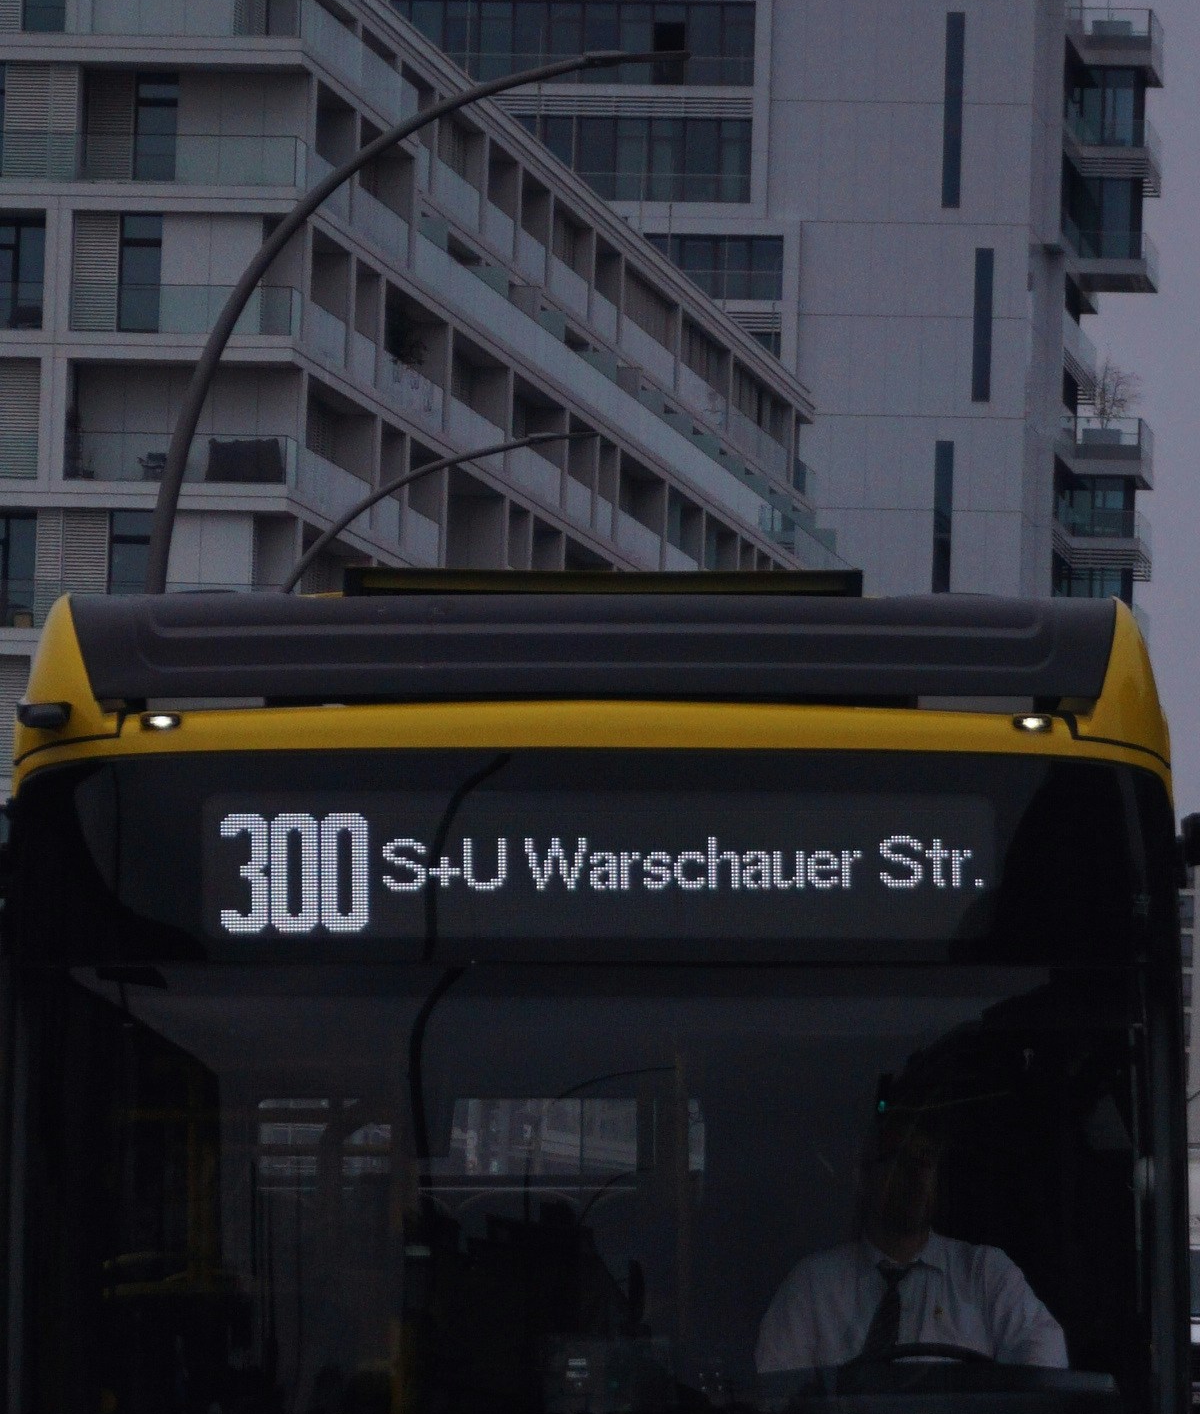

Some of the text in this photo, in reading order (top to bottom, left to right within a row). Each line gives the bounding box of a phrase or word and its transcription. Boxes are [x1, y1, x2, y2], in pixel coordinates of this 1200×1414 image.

[220, 812, 985, 933] 300 S+U Warschauer Str.
